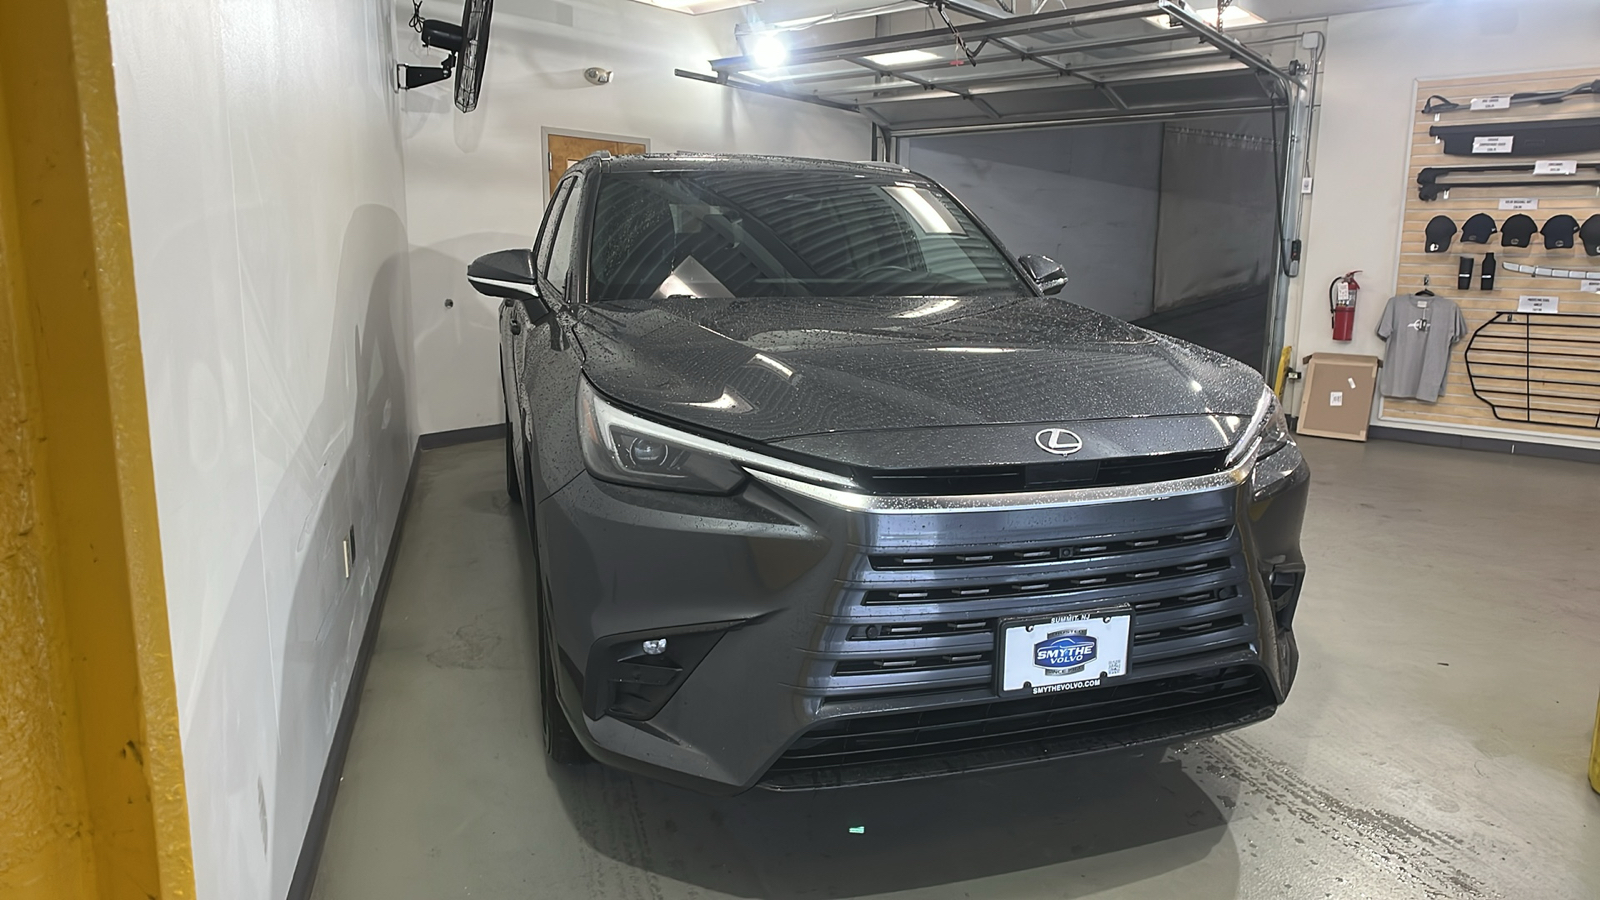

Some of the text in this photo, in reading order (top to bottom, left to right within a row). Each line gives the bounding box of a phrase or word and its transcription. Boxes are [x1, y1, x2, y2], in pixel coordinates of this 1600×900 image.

[1081, 613, 1091, 621] NJ
[1037, 646, 1092, 659] SMYTHE
[1050, 655, 1084, 664] VOLVO
[1033, 679, 1101, 694] SMYTHEVOLVO.COM
